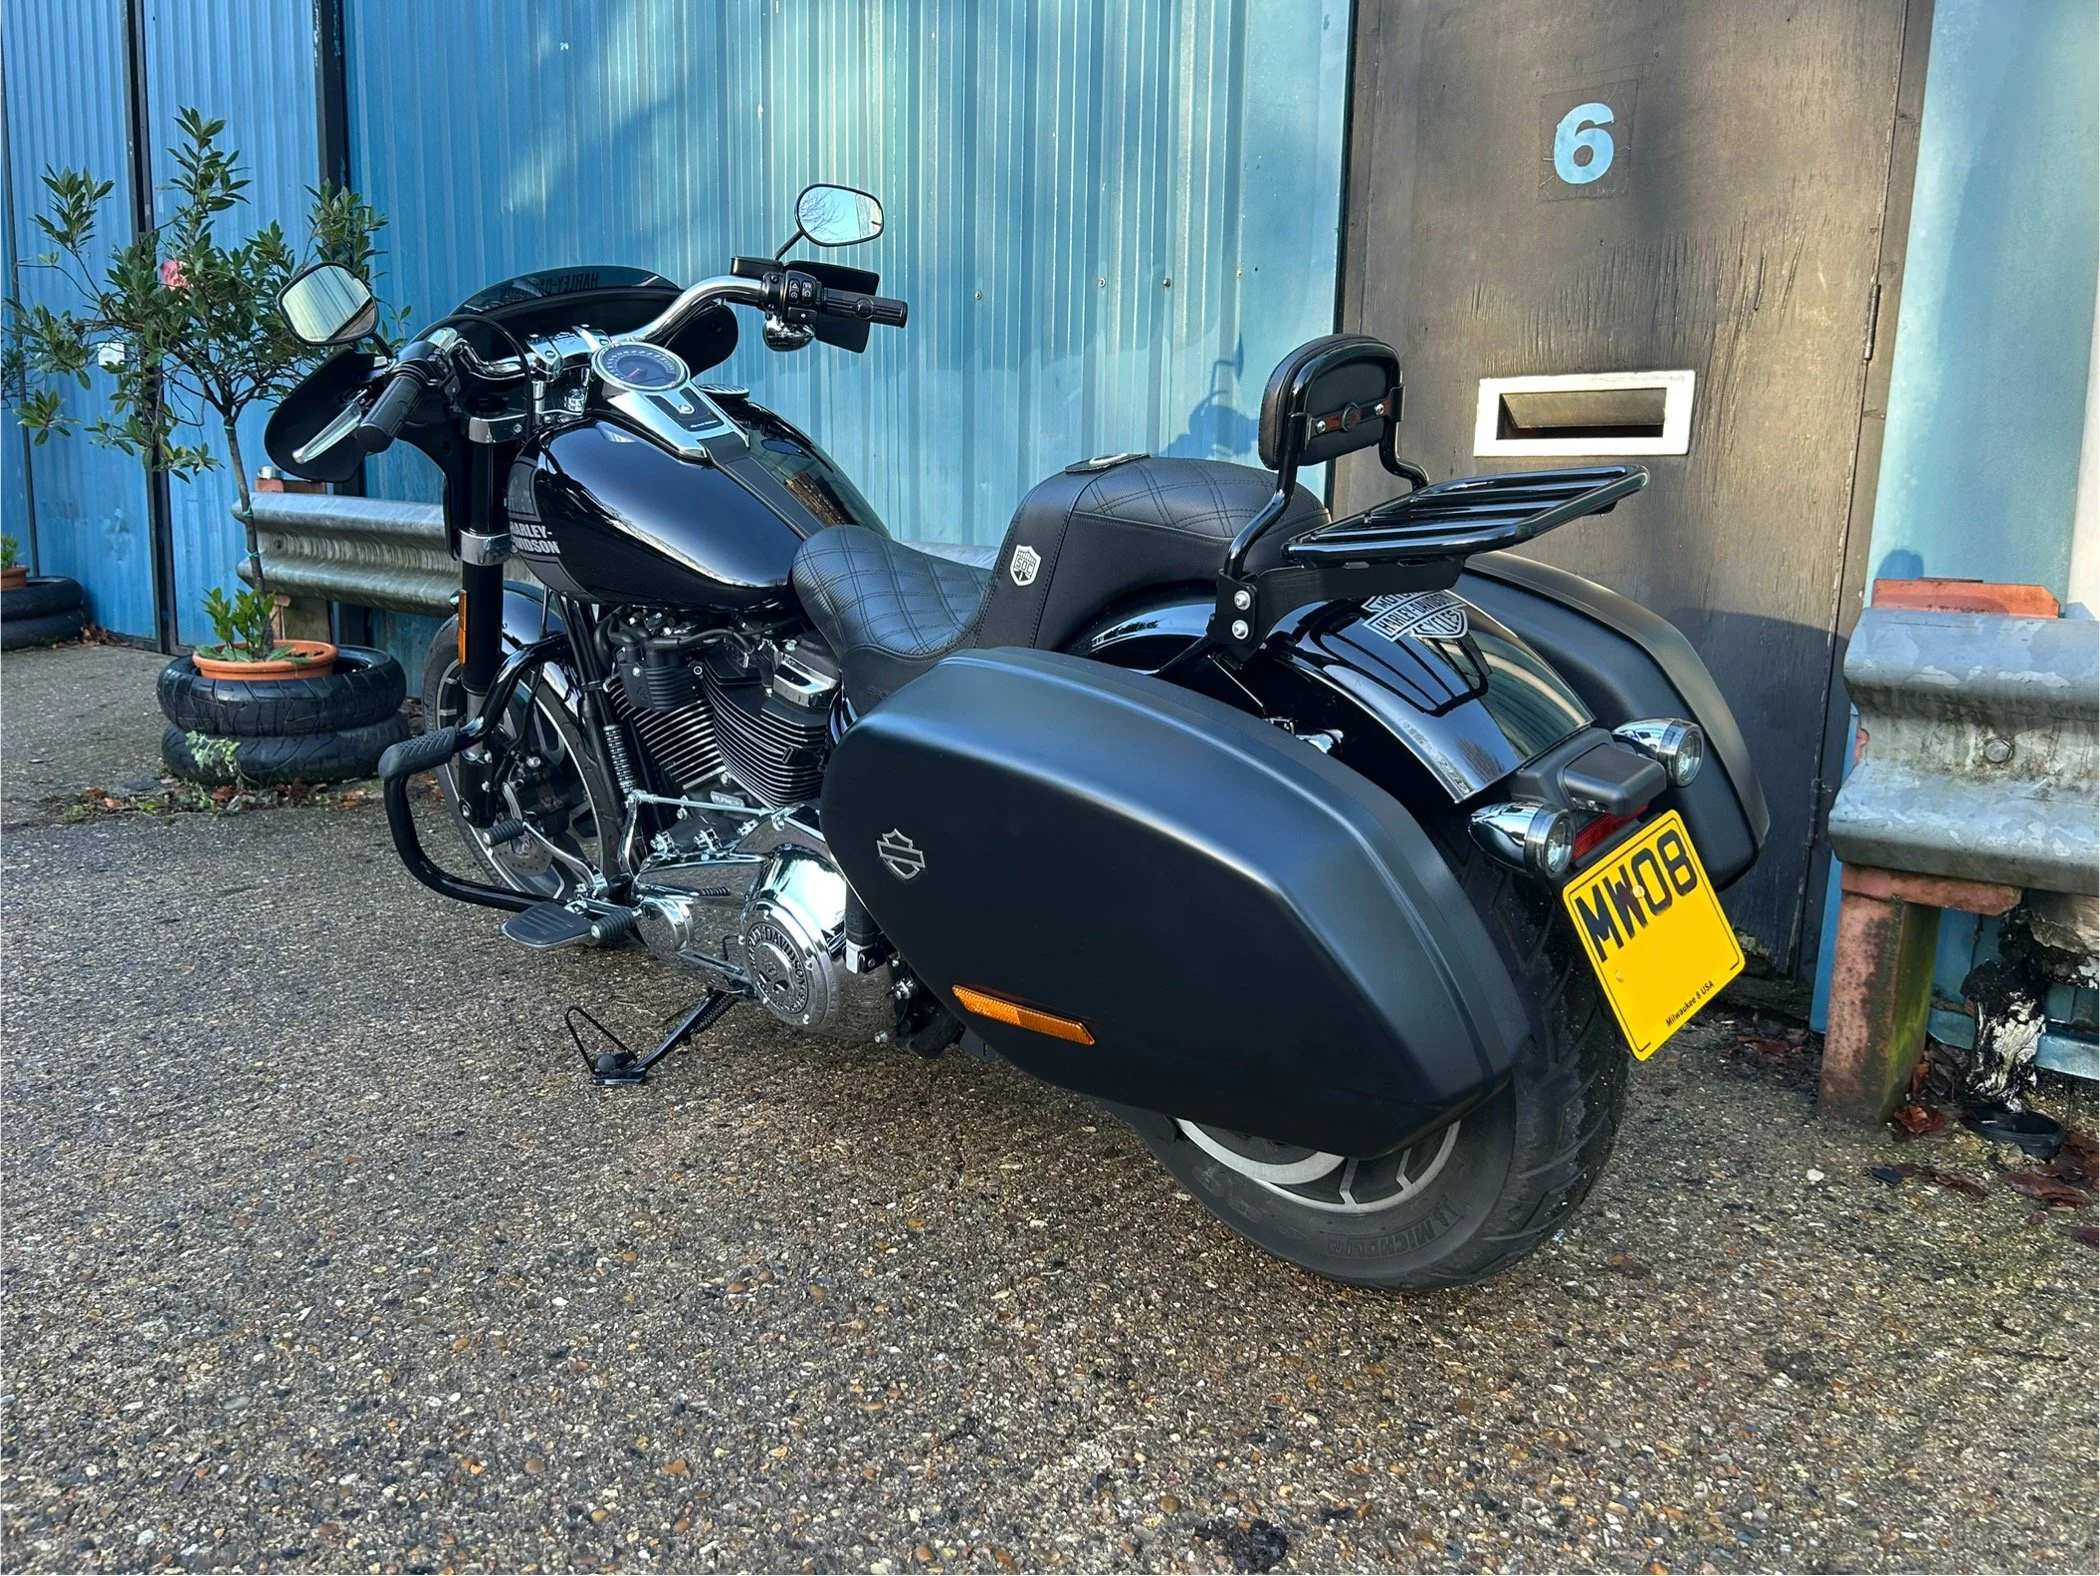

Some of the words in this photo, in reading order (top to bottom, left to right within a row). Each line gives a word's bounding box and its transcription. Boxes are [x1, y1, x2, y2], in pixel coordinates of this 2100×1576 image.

[1554, 102, 1614, 185] 6
[511, 535, 561, 554] VIDSON
[1375, 593, 1454, 633] HARLEY-DAVI
[1416, 609, 1460, 633] CYCLES
[1665, 997, 1697, 1027] Milwaukee
[1695, 990, 1702, 1000] 8
[1700, 980, 1715, 995] USA
